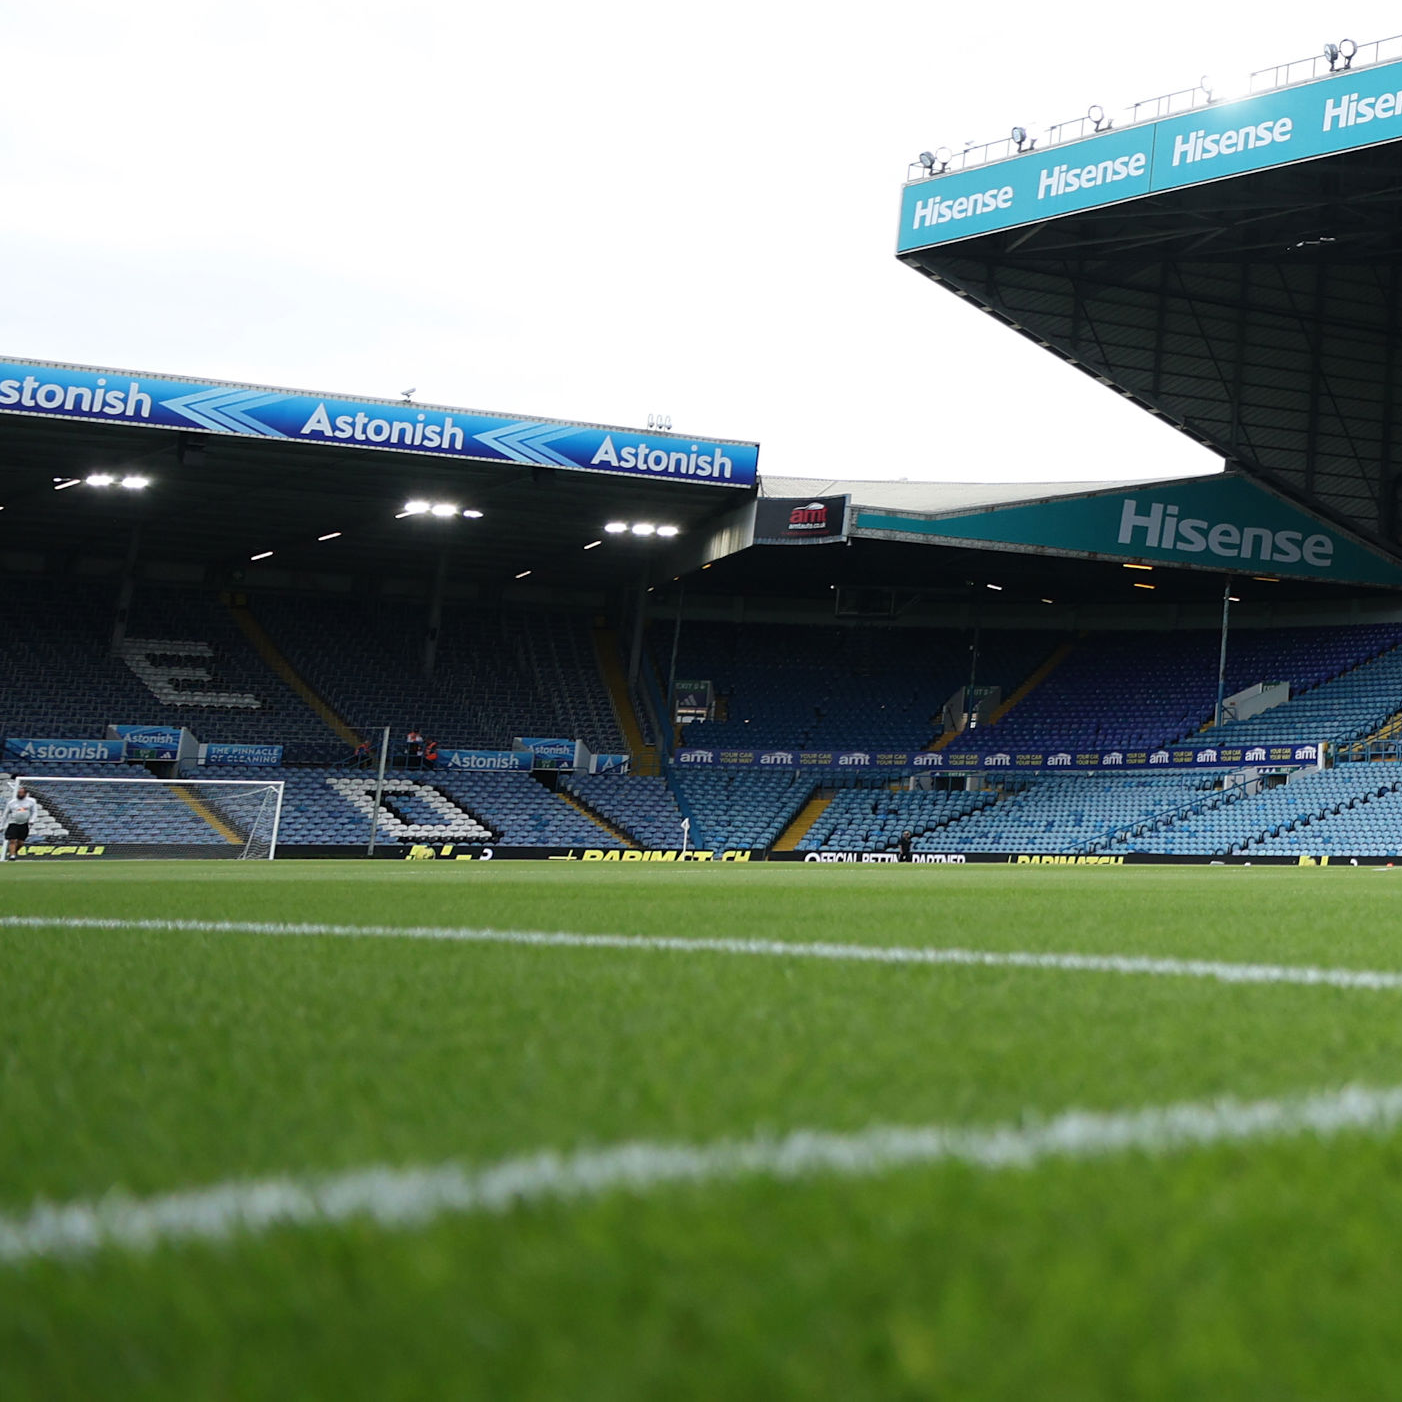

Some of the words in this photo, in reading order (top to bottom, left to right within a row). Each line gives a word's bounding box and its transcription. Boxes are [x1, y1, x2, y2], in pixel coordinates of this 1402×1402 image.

[1172, 116, 1293, 167] Hisense
[1037, 151, 1146, 200] Hisense
[912, 185, 1013, 230] Hisense
[0, 376, 152, 417] stonish
[300, 402, 464, 450] Astonish
[590, 435, 732, 478] Astonish
[789, 506, 828, 524] amt
[1118, 499, 1334, 567] Hisense
[123, 733, 173, 744] Astonish
[20, 741, 108, 761] Astonish
[211, 746, 229, 755] THE
[231, 746, 279, 756] PINNACLE
[680, 751, 713, 763] amt
[1149, 751, 1170, 763] amt
[1197, 749, 1217, 762] amt
[1245, 748, 1266, 761] amt
[1295, 746, 1316, 759] amt
[227, 755, 277, 764] CLEANING
[449, 752, 519, 770] Astonish
[760, 752, 792, 764] amt
[838, 753, 870, 765] amt
[913, 753, 943, 765] amt
[984, 753, 1011, 765] amt
[1047, 753, 1072, 765] amt
[1102, 752, 1123, 764] amt
